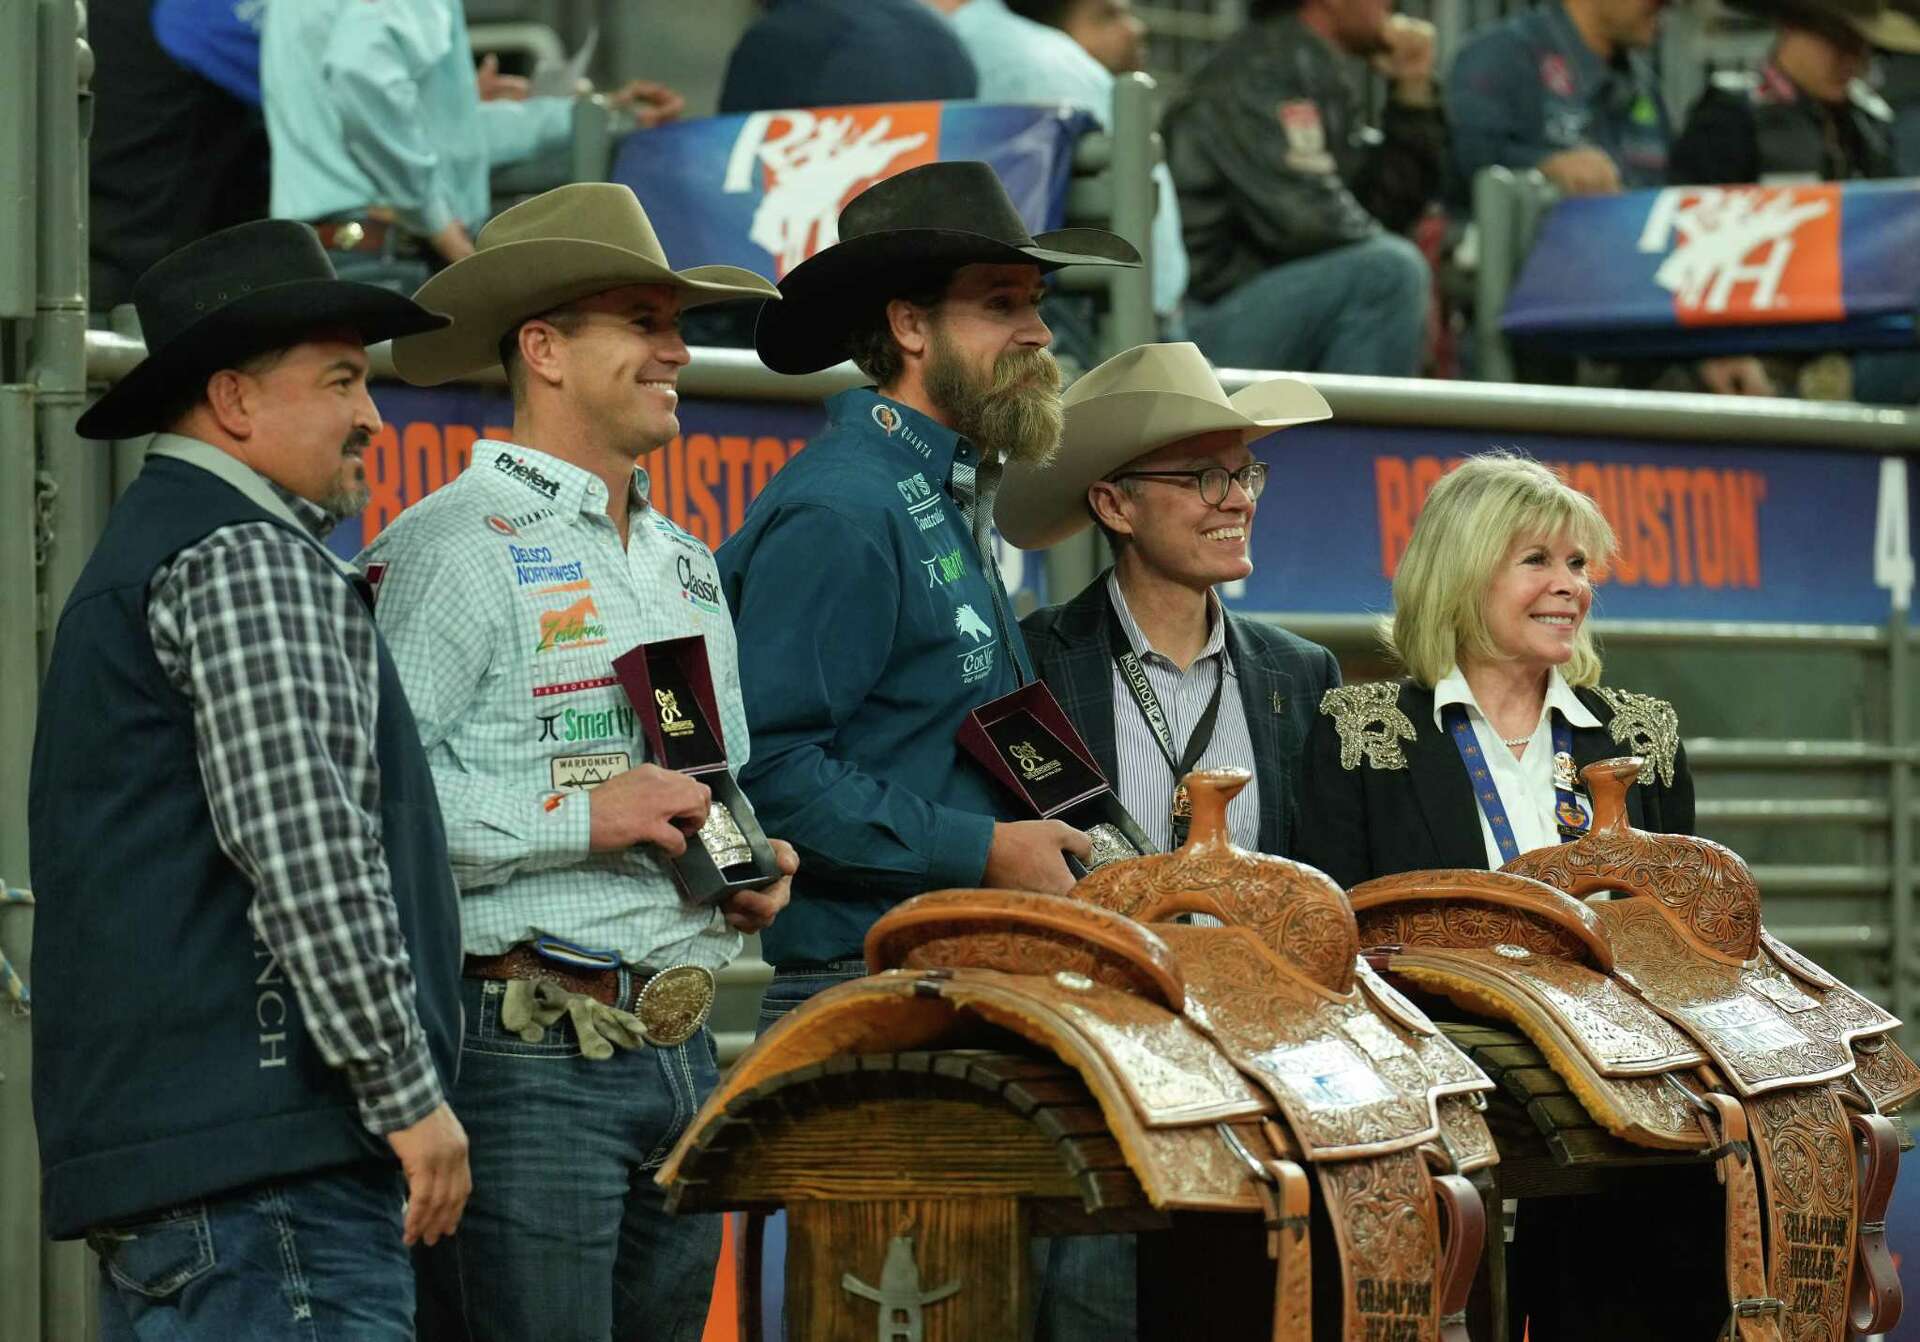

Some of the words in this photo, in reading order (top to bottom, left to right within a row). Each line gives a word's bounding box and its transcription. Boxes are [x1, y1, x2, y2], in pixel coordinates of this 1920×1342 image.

[494, 452, 560, 498] Priefert
[516, 560, 583, 586] NORTHWEST
[677, 554, 720, 605] Classic
[564, 706, 635, 742] Smarty
[559, 756, 622, 769] WARBONNET
[253, 930, 287, 1069] NCH
